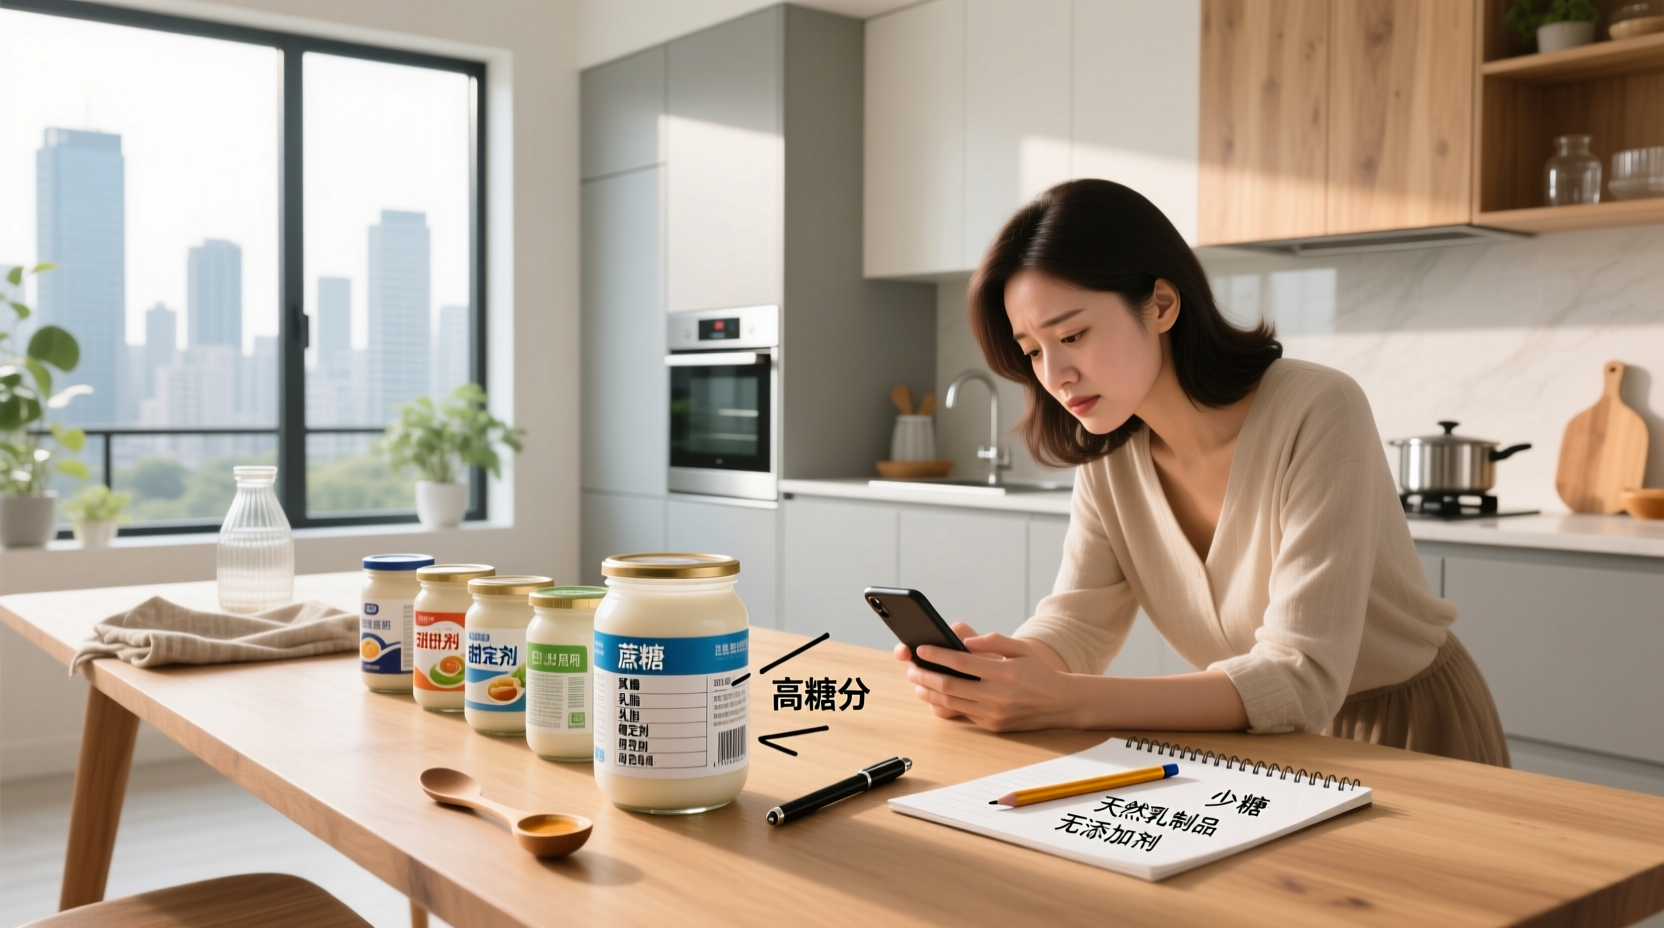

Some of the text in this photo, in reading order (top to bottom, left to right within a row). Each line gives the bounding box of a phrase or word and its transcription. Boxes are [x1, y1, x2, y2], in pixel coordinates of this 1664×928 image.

[618, 643, 665, 671] 蔗糖
[1094, 795, 1220, 837] 天然乳制品
[1205, 789, 1270, 817] 少糖
[1055, 812, 1163, 852] 无添加剂
